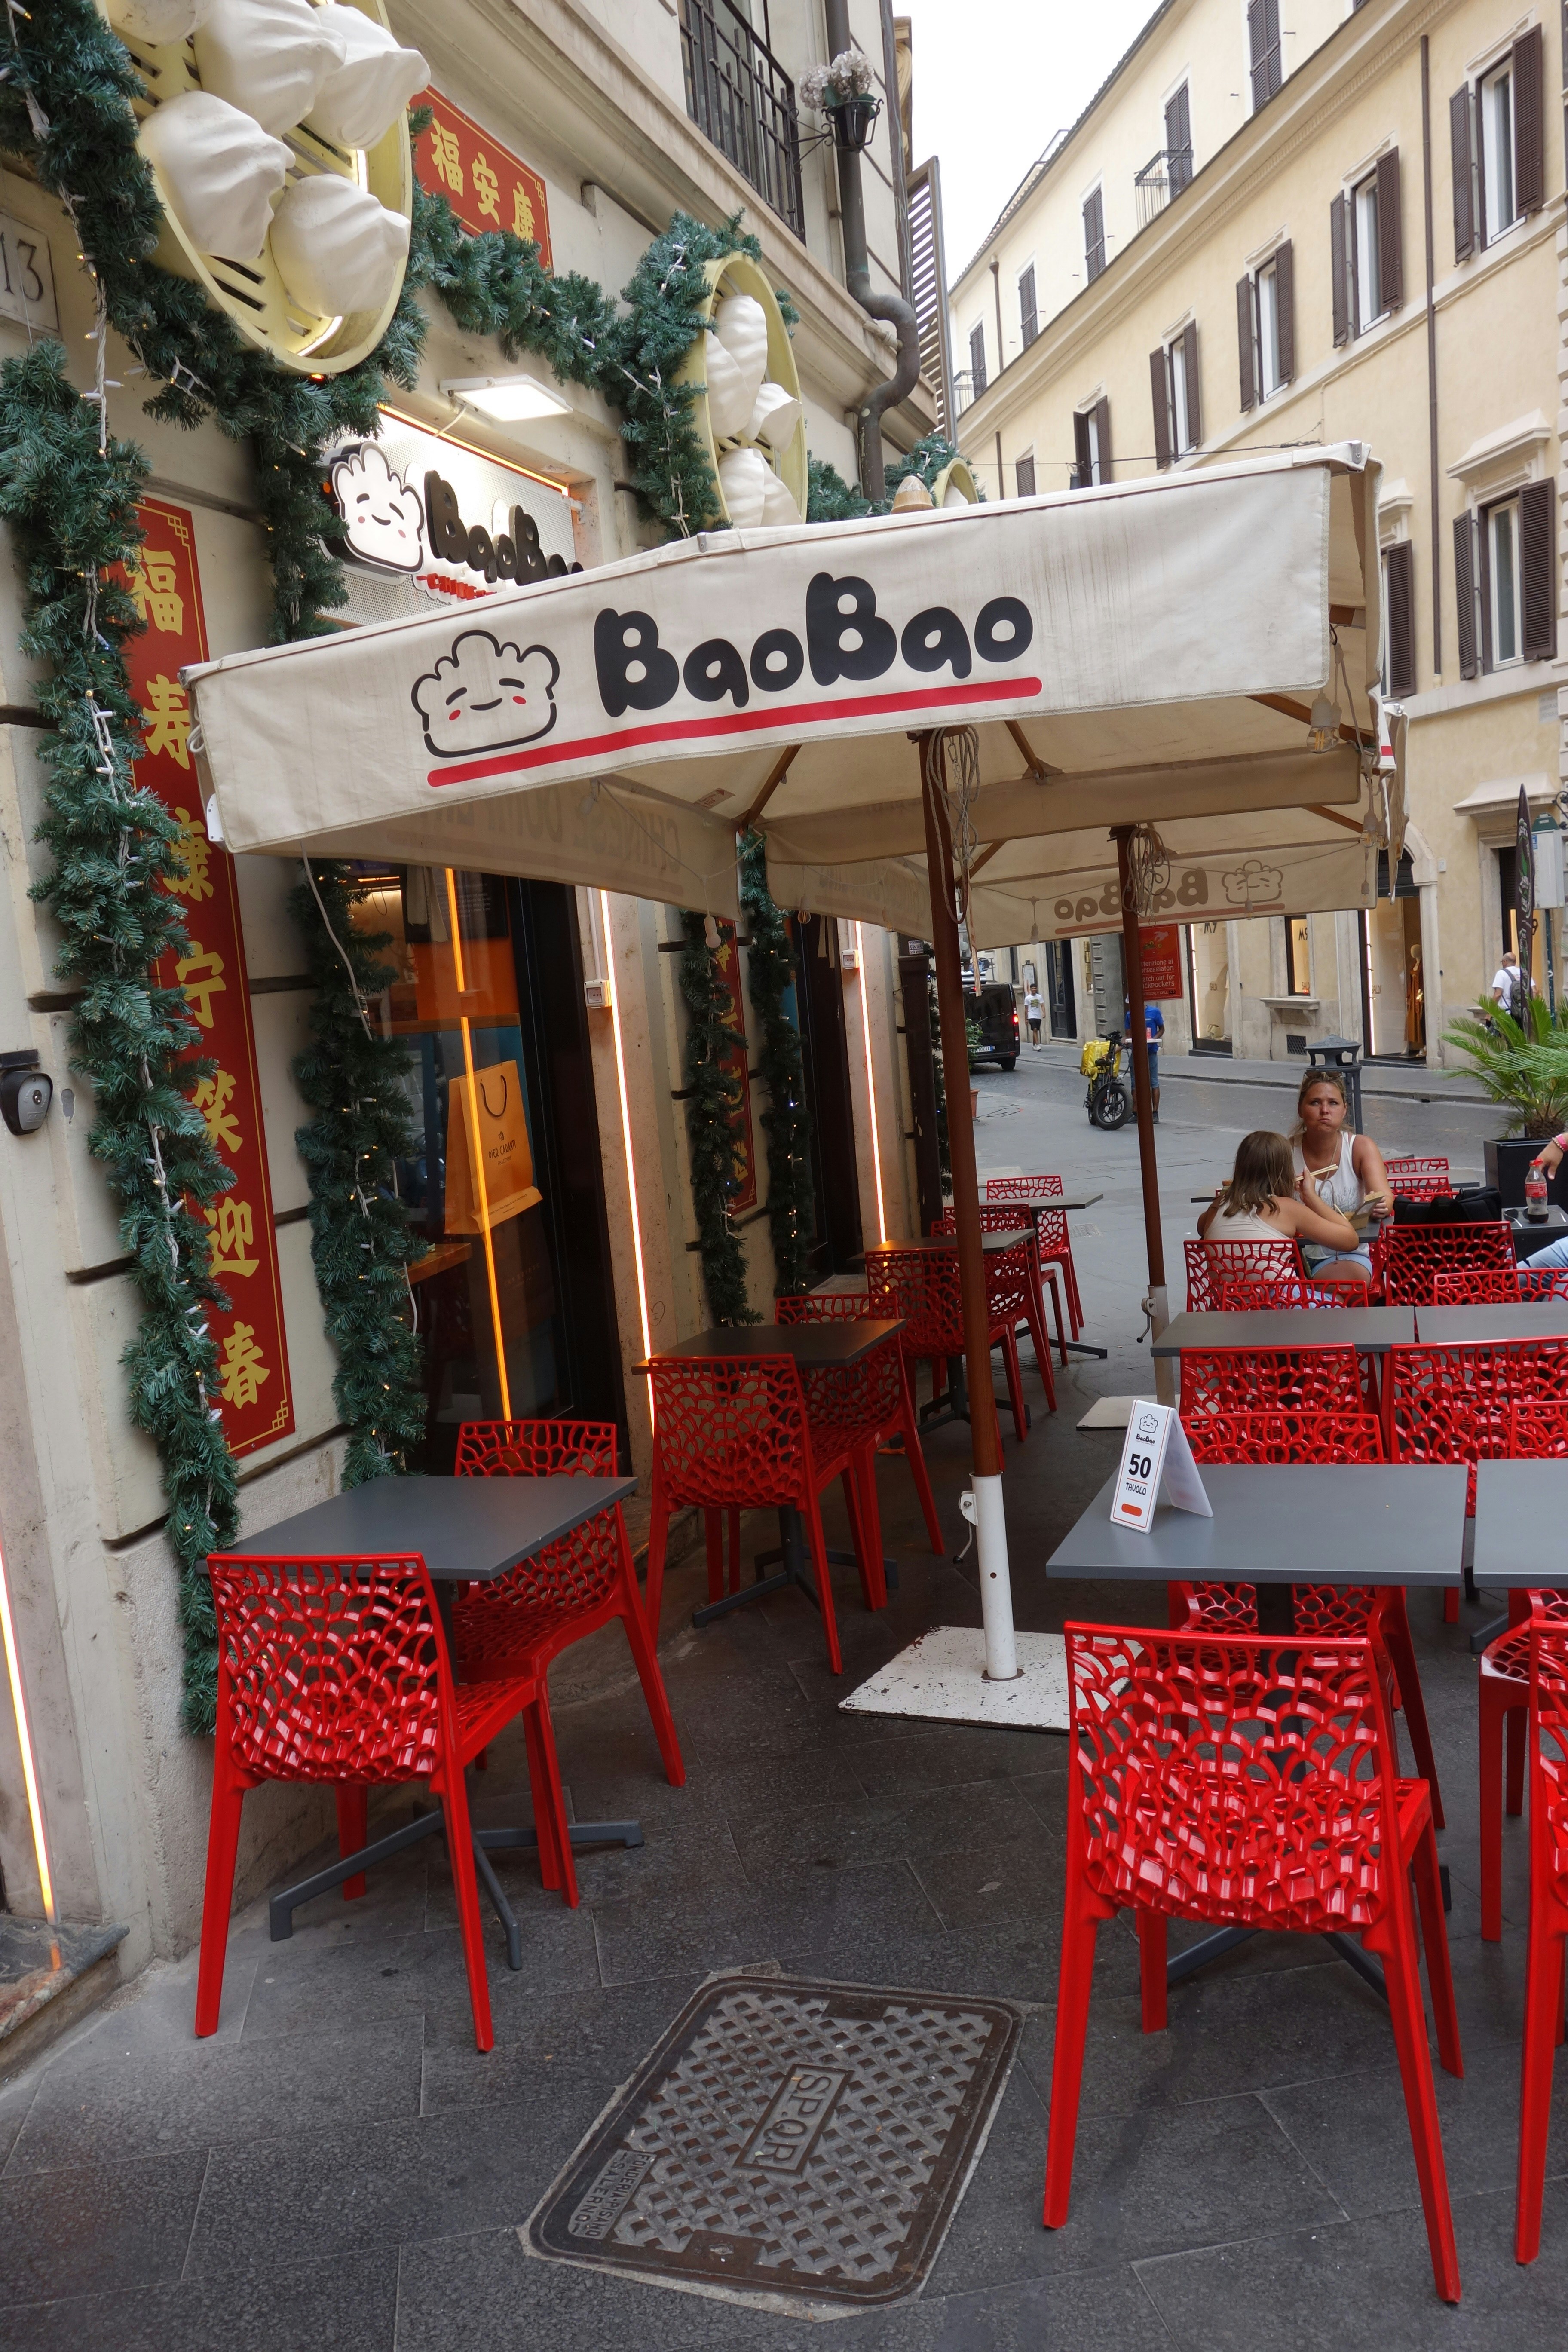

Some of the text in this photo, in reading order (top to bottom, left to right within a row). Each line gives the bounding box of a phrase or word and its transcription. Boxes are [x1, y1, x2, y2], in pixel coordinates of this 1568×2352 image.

[407, 113, 536, 244] 福安康
[424, 470, 583, 586] BaoB
[594, 572, 1033, 717] BaoBao
[1142, 965, 1174, 974] orseggiatori
[1142, 980, 1175, 989] ickpockets
[488, 1139, 516, 1161] PIER CARANTI
[1136, 1433, 1155, 1444] BaoBao
[1128, 1453, 1152, 1479] 50
[1126, 1482, 1147, 1496] TAVOLO
